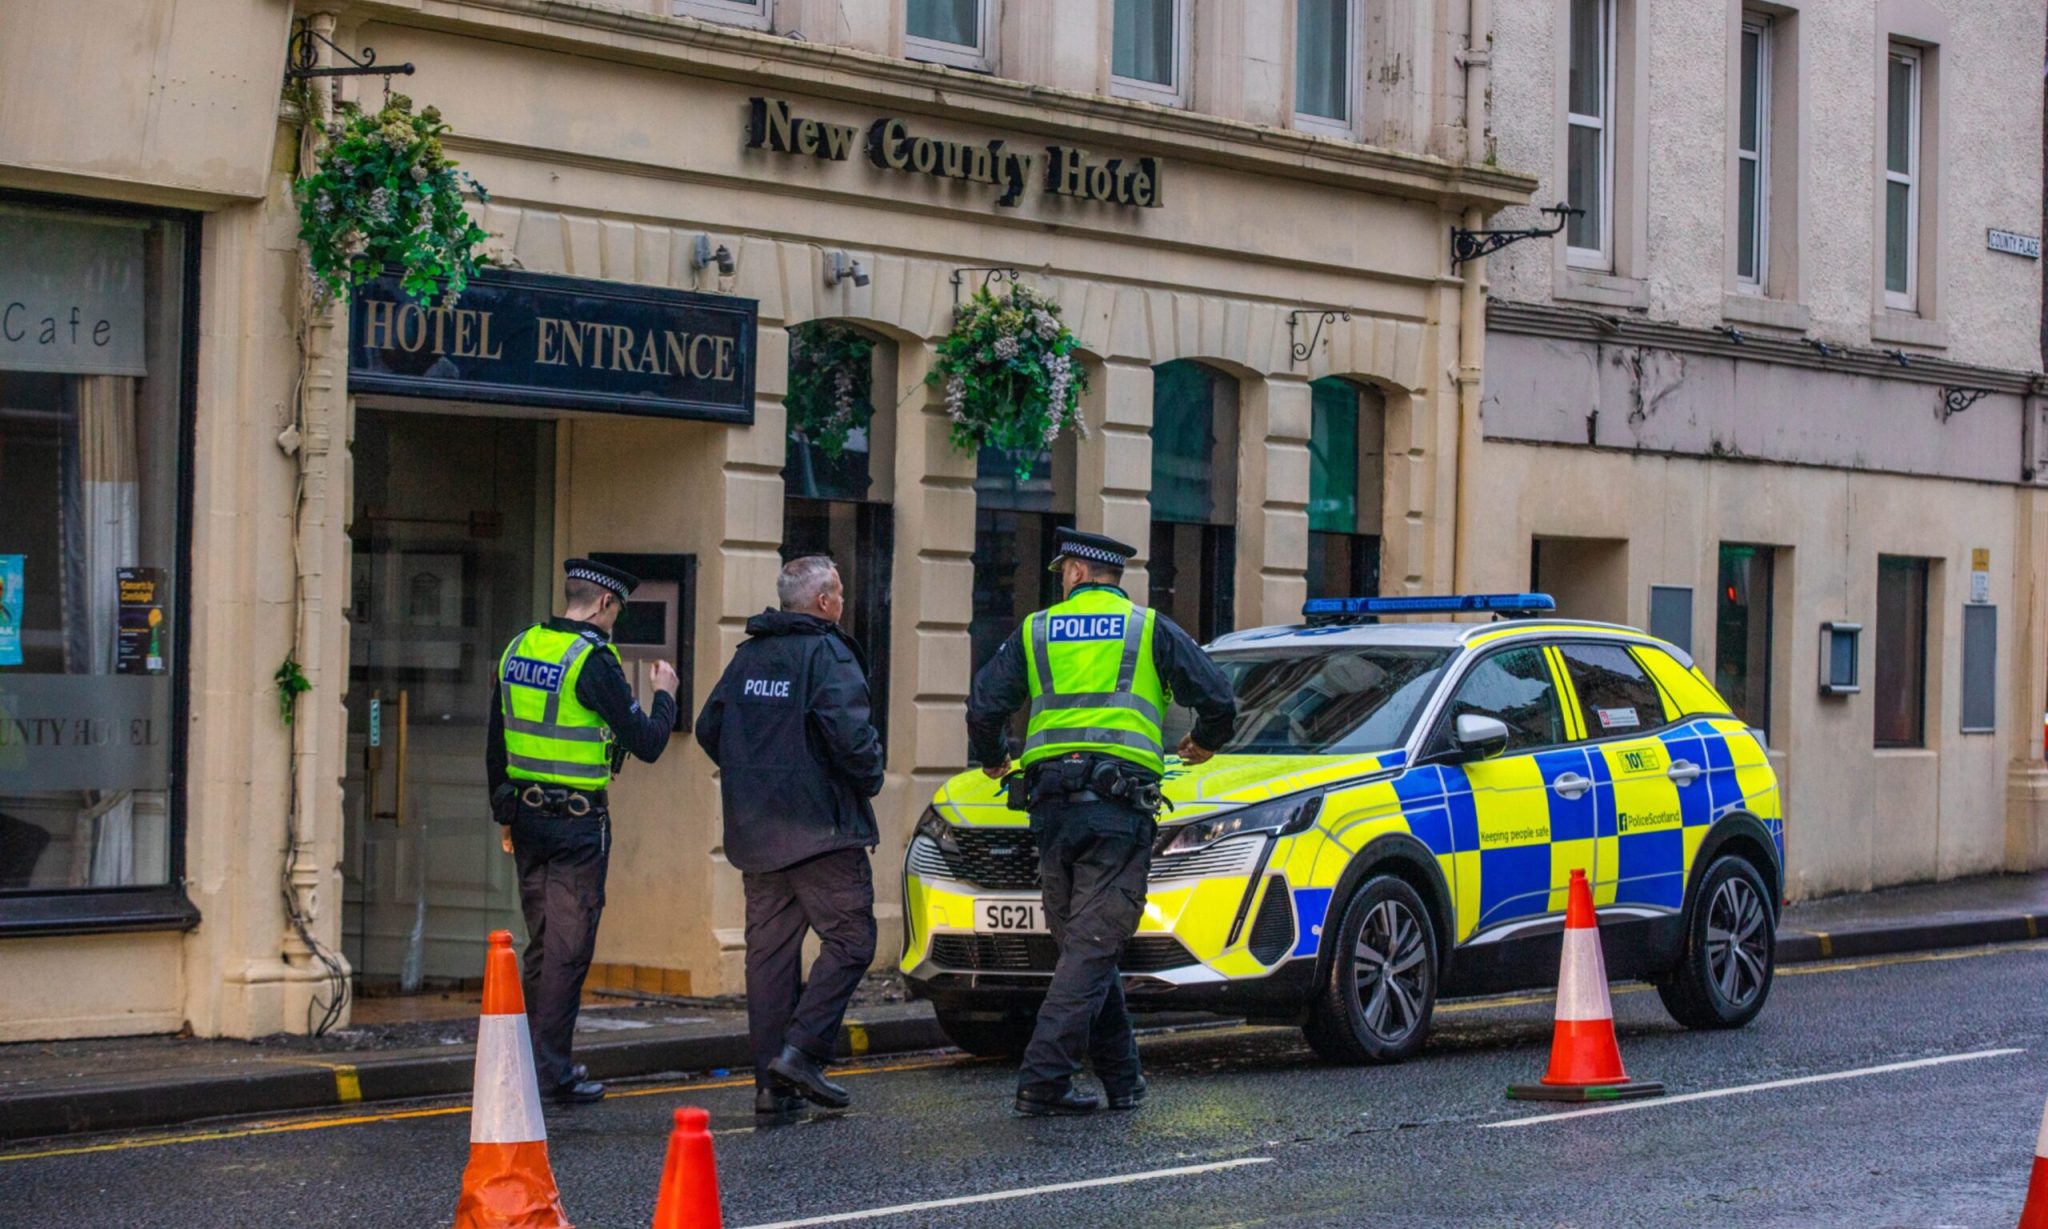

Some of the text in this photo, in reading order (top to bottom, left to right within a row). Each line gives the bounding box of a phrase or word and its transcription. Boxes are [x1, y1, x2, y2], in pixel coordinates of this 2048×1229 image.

[753, 98, 1164, 208] New County Hotel
[1990, 232, 2040, 255] COUNTY PLACE
[3, 302, 111, 347] Cafe
[363, 299, 735, 382] HOTEL ENTRANCE
[1051, 617, 1122, 638] POLICE
[505, 659, 559, 688] POLICE
[744, 679, 791, 697] POLICE
[1625, 752, 1644, 769] 101
[1628, 809, 1681, 828] PoliceScotland
[1481, 825, 1549, 844] Keeping people safe
[986, 905, 1035, 930] SG21
